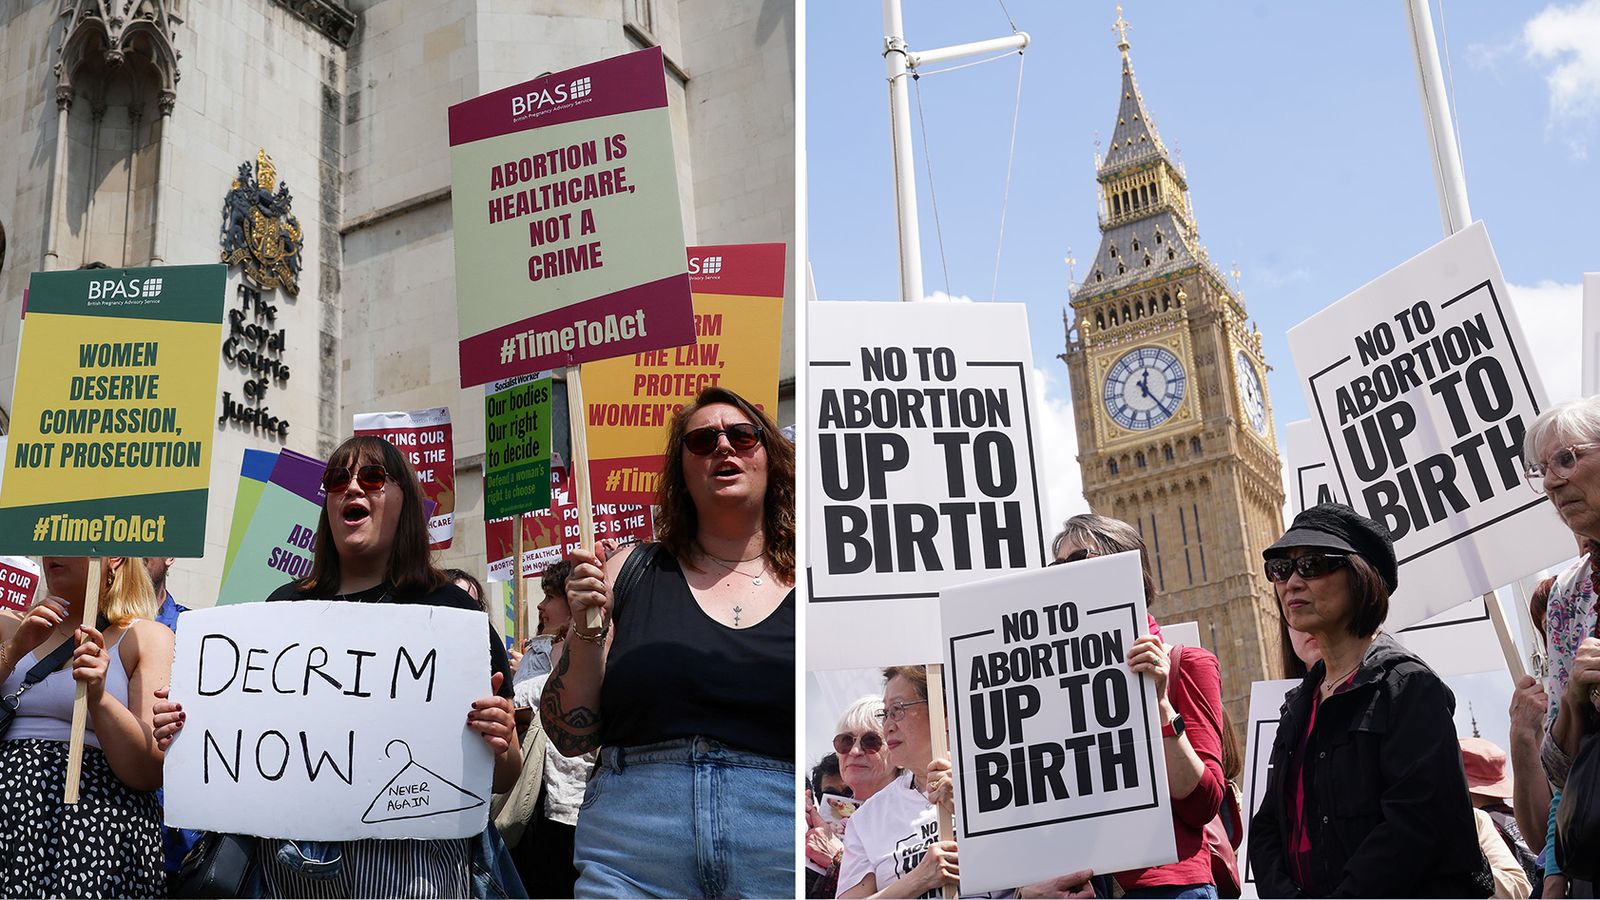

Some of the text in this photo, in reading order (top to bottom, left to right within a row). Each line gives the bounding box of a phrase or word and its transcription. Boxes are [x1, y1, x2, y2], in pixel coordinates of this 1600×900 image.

[512, 83, 568, 116] BPAS
[575, 98, 593, 106] Service
[490, 133, 628, 191] ABORTION IS
[488, 166, 636, 225] HEALTHCARE,
[529, 208, 597, 247] NOT A
[527, 240, 604, 282] CRIME
[88, 279, 140, 299] BPAS
[237, 283, 278, 320] The
[229, 308, 286, 352] Royal
[500, 308, 648, 365] #TimeToAct
[1354, 299, 1436, 368] NO TO
[79, 342, 158, 368] WOMEN
[222, 336, 290, 380] Courts
[674, 344, 725, 369] LAW,
[860, 346, 957, 382] NO TO
[1334, 312, 1495, 426] ABORTION
[69, 375, 159, 401] DESERVE
[243, 377, 270, 400] of
[494, 372, 540, 392] Socialist Worker
[633, 373, 721, 396] PROTECT
[218, 391, 290, 436] Justice
[488, 385, 548, 418] Our bodies
[818, 387, 1011, 429] ABORTION
[39, 407, 182, 436] COMPASSION,
[488, 410, 538, 443] Our right
[1341, 355, 1514, 483] UP TO
[14, 441, 201, 468] NOT PROSECUTION
[420, 431, 444, 445] OUR
[488, 437, 540, 468] to decide
[409, 449, 446, 465] IS THE
[818, 430, 1017, 501] UP TO
[487, 472, 509, 488] Defend
[516, 464, 545, 481] woman's
[1361, 413, 1526, 542] BIRTH
[487, 489, 503, 506] right
[504, 488, 511, 500] to
[512, 484, 536, 498] choose
[32, 513, 166, 543] #TimeToAct
[563, 504, 617, 520] POCING
[564, 515, 645, 537] BOES IS THE
[823, 500, 1027, 575] BIRTH
[267, 546, 314, 579] SHOU
[490, 559, 514, 572] ABORTIO
[9, 572, 31, 589] OUR
[7, 589, 27, 606] THE
[1001, 601, 1078, 644] NO TO
[197, 633, 437, 702] DECRIM
[969, 629, 1124, 691] ABORTION
[969, 668, 1130, 750] UP TO
[203, 728, 355, 786] NOW
[974, 727, 1139, 814] BIRTH
[386, 794, 431, 812] AGAIN
[388, 781, 431, 797] NEVER
[920, 820, 938, 839] NO
